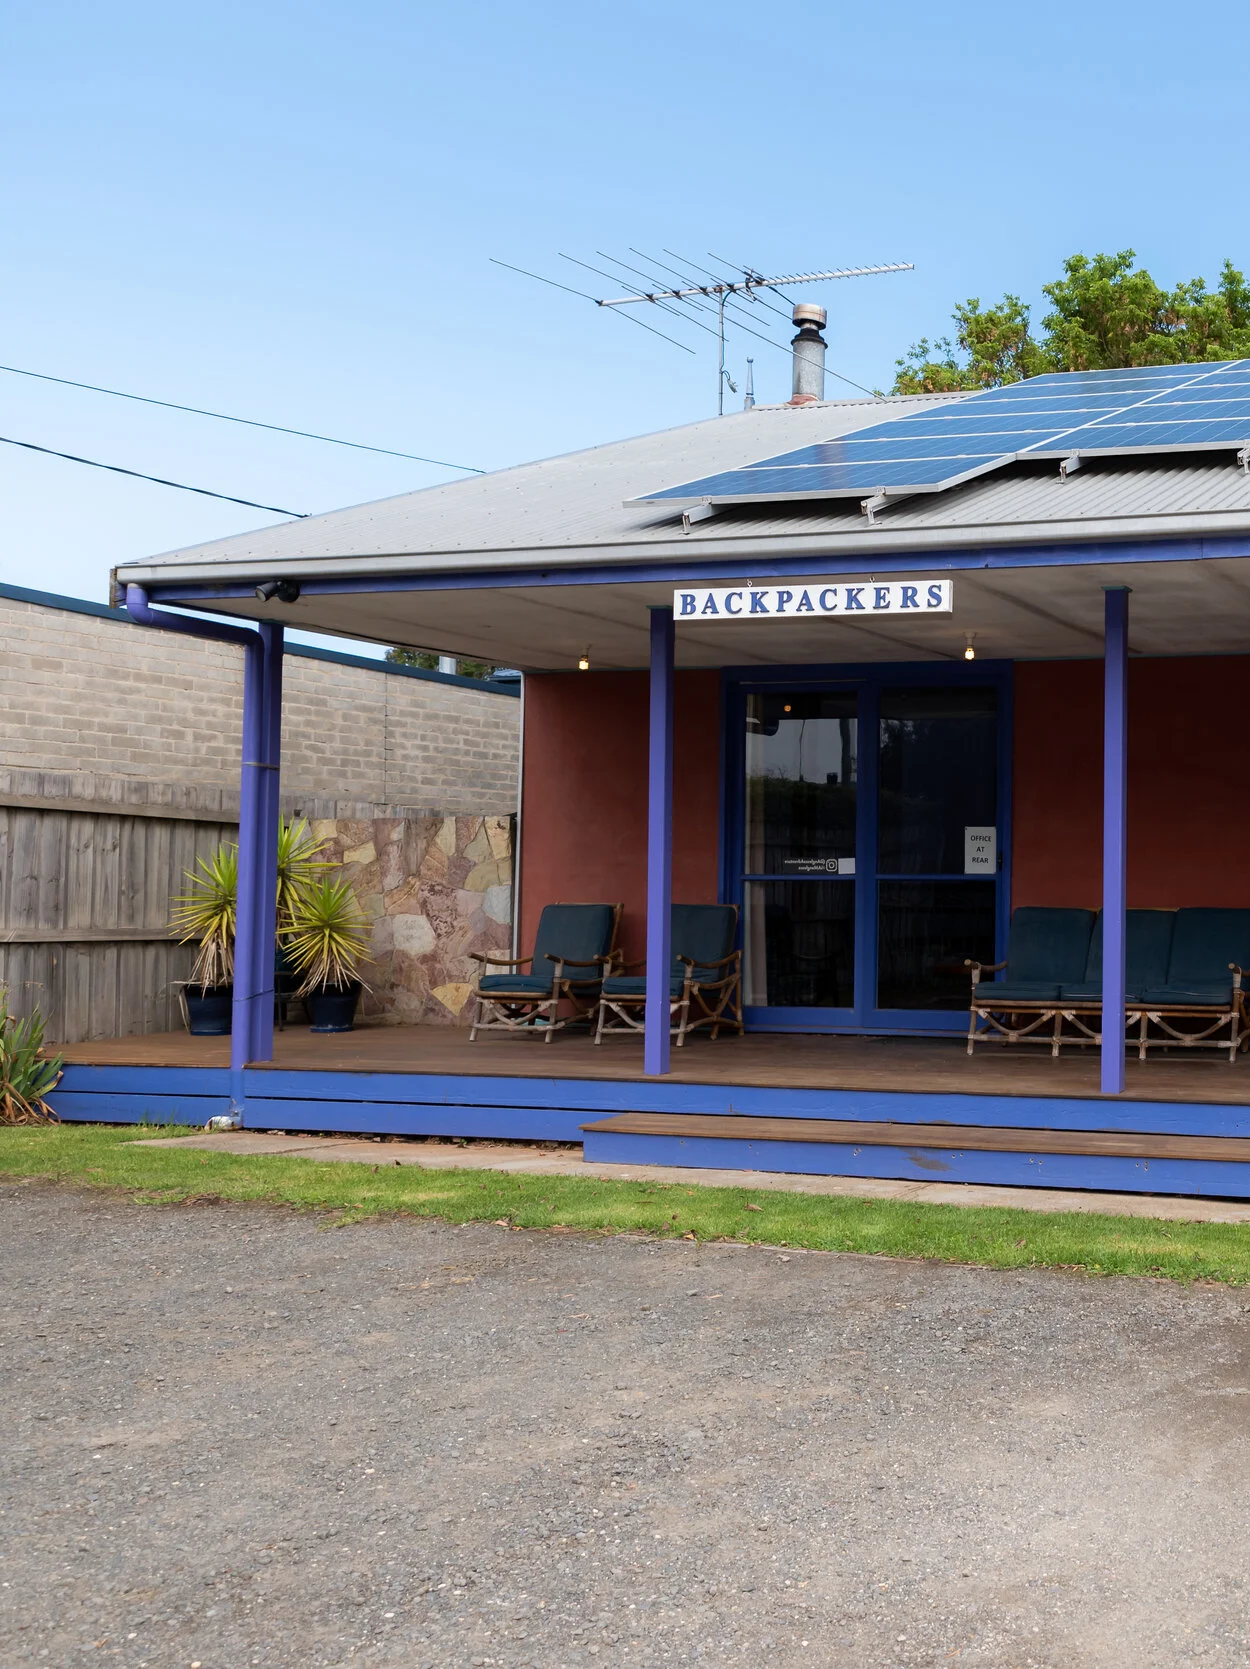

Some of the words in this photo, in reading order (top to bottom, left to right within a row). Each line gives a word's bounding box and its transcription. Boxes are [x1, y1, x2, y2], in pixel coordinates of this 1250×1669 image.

[679, 584, 943, 616] BACKPACKERS
[970, 834, 992, 843] OFFICE
[971, 856, 989, 864] REAR
